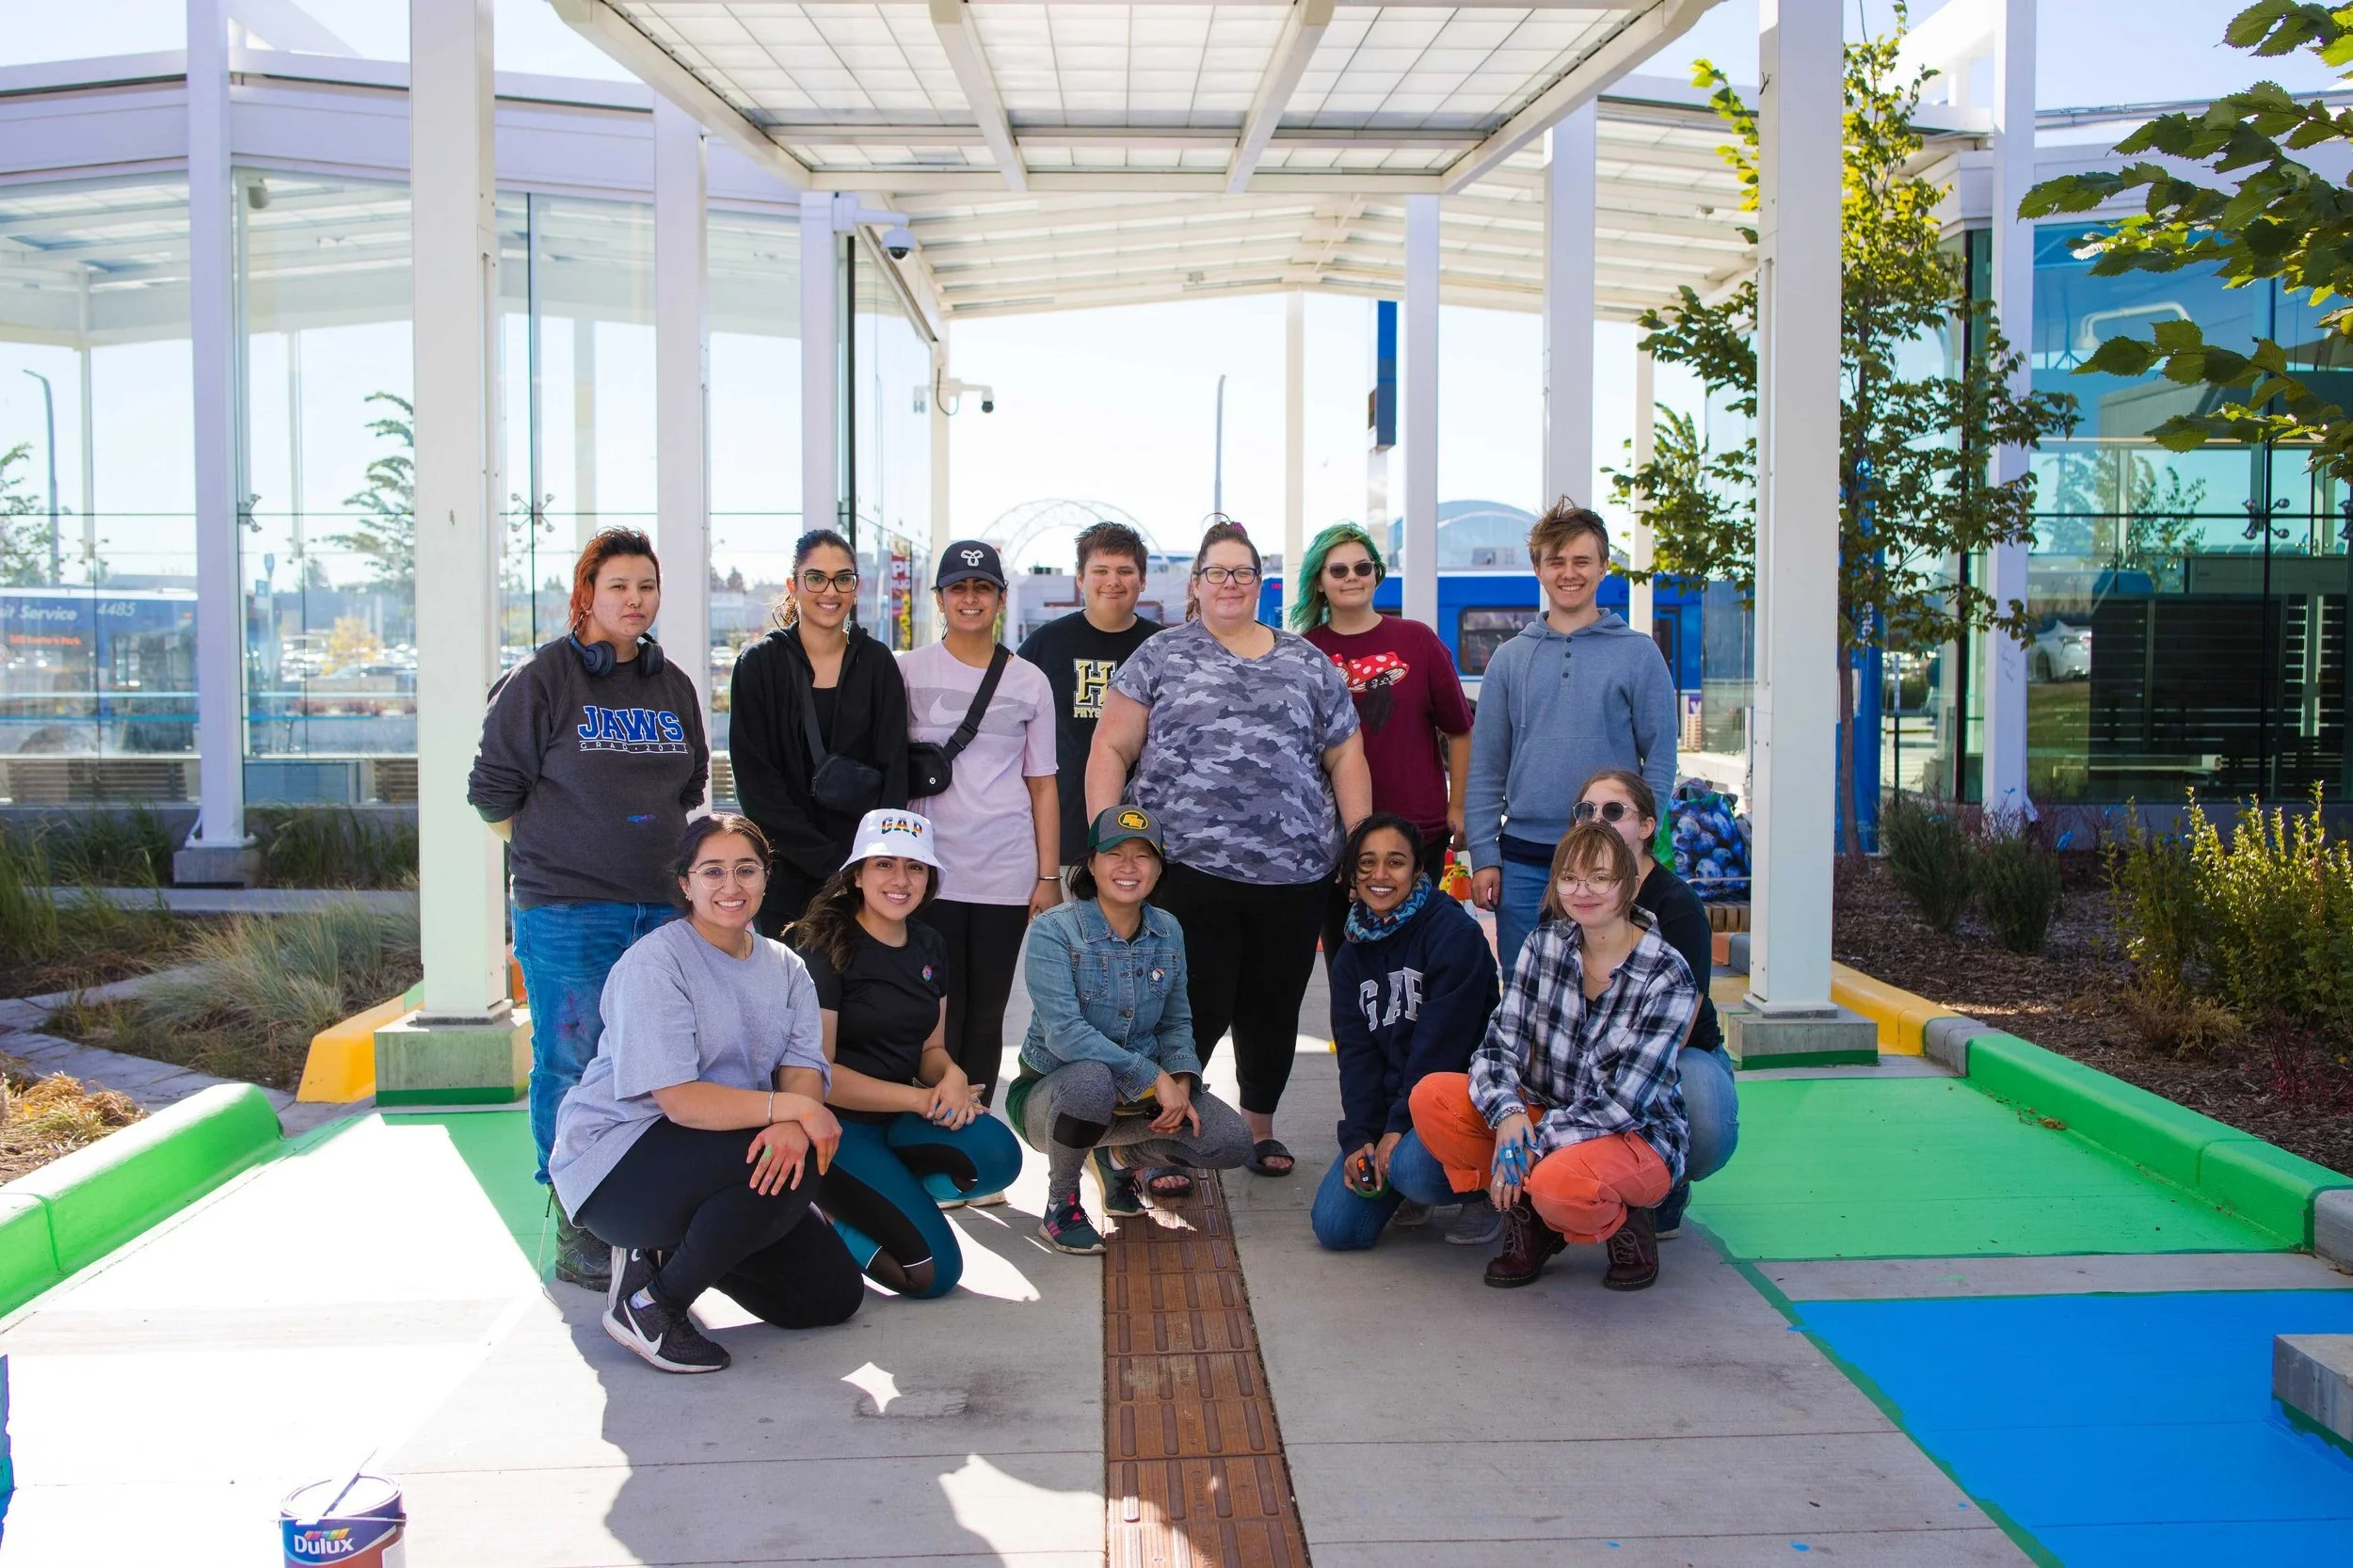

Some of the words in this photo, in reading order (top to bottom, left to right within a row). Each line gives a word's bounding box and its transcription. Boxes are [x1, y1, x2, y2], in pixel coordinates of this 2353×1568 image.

[19, 604, 78, 621] Service
[96, 601, 136, 617] 4485
[1074, 659, 1117, 708] H
[578, 705, 684, 742] JAWS
[881, 816, 923, 838] GAP
[294, 1534, 354, 1555] Dulux
